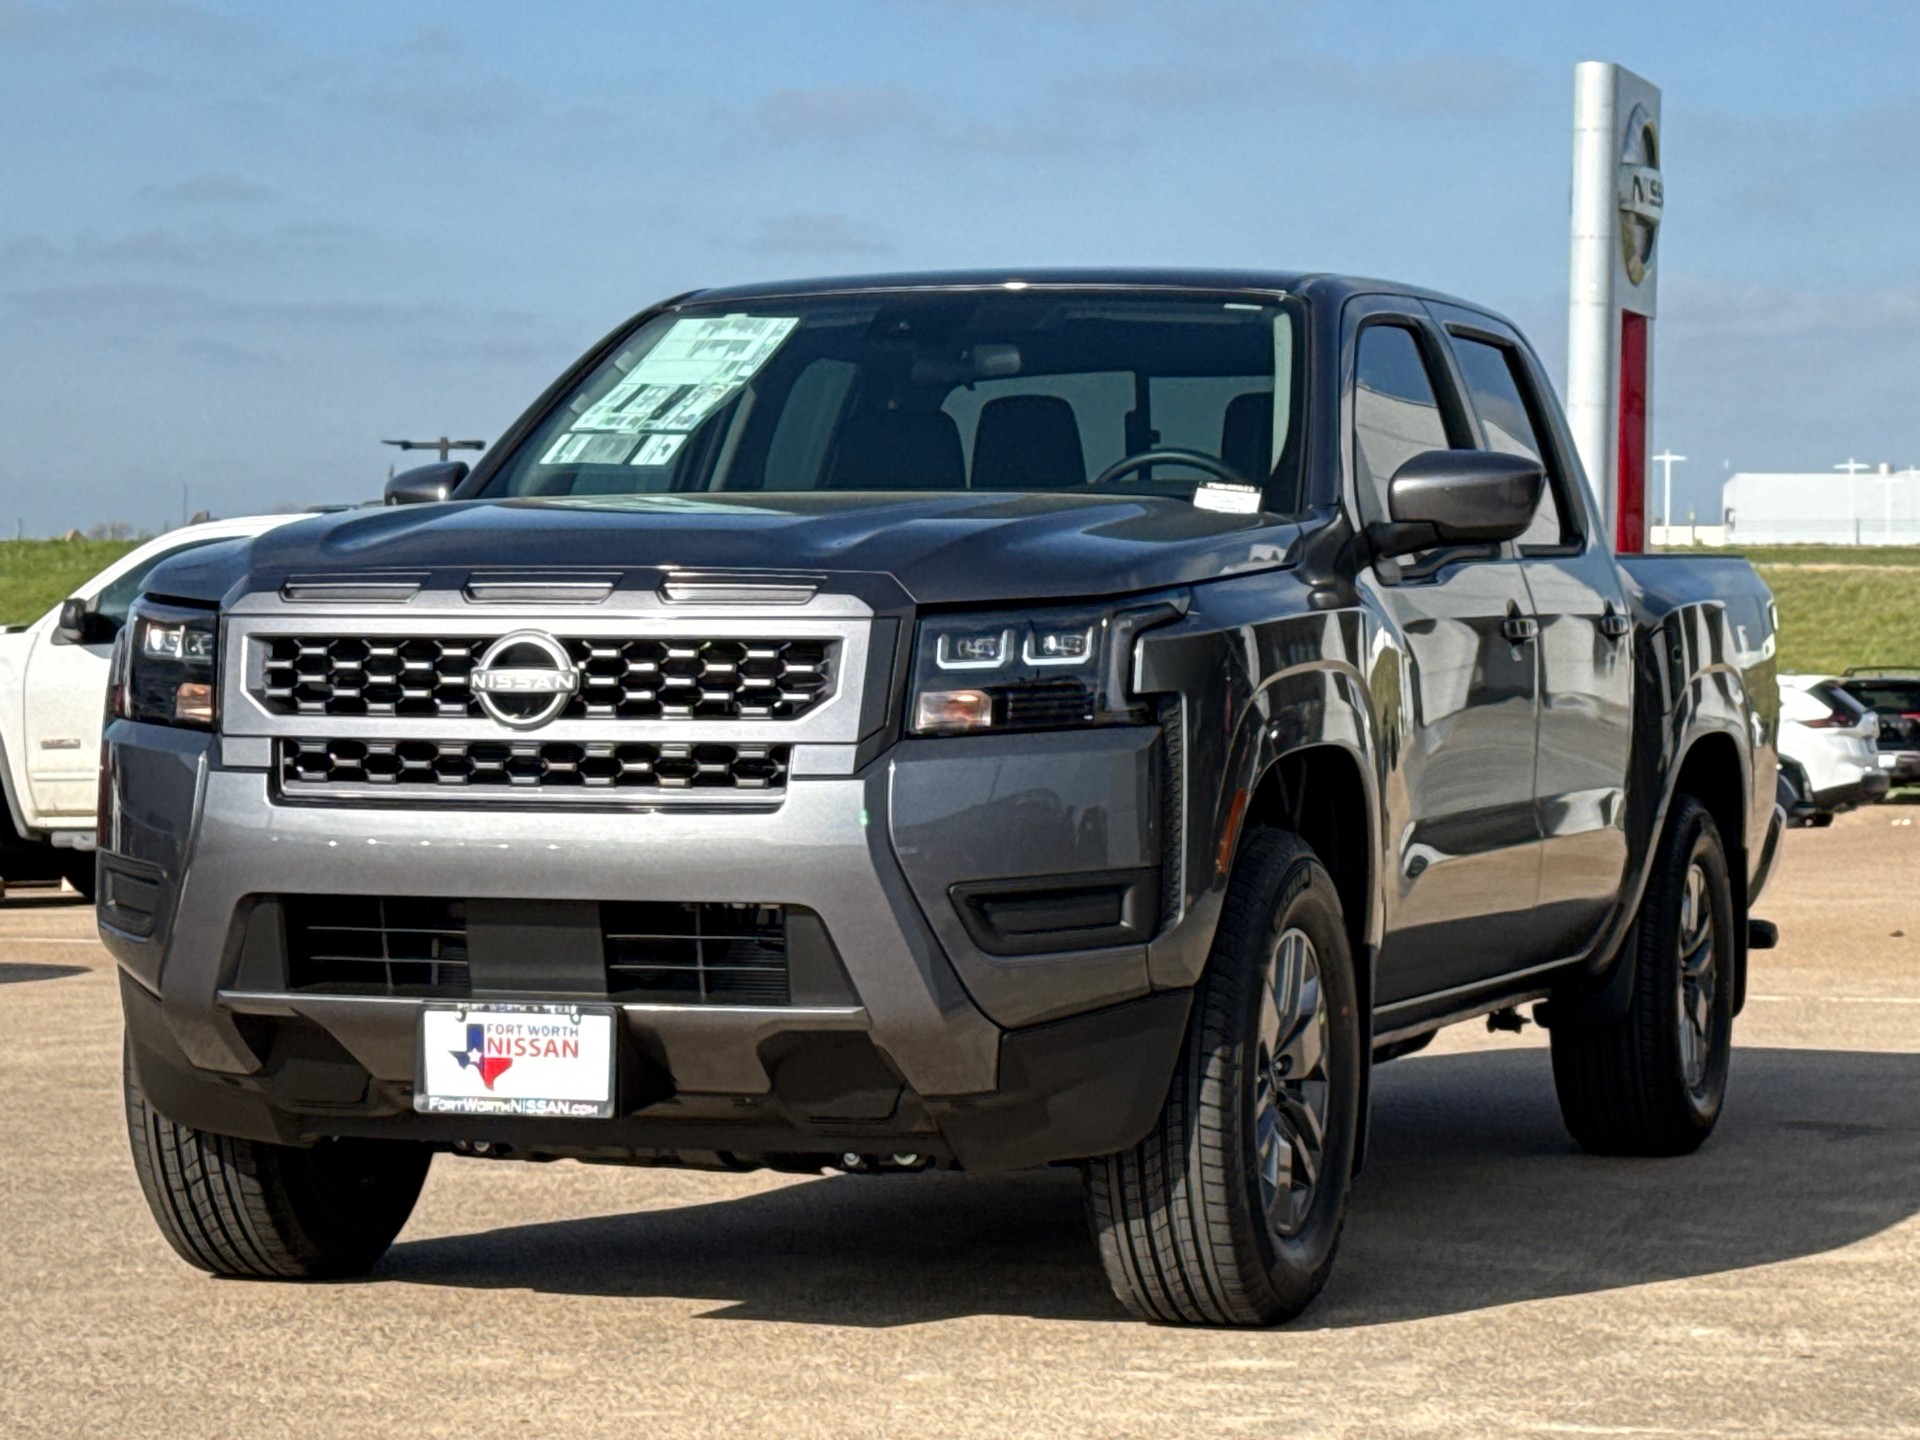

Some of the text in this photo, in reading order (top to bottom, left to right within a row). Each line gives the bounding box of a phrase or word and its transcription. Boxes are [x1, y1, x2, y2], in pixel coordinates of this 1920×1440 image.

[471, 673, 574, 689] NISSAN
[486, 1023, 579, 1037] FORT WORTH
[487, 1037, 579, 1059] NISSAN
